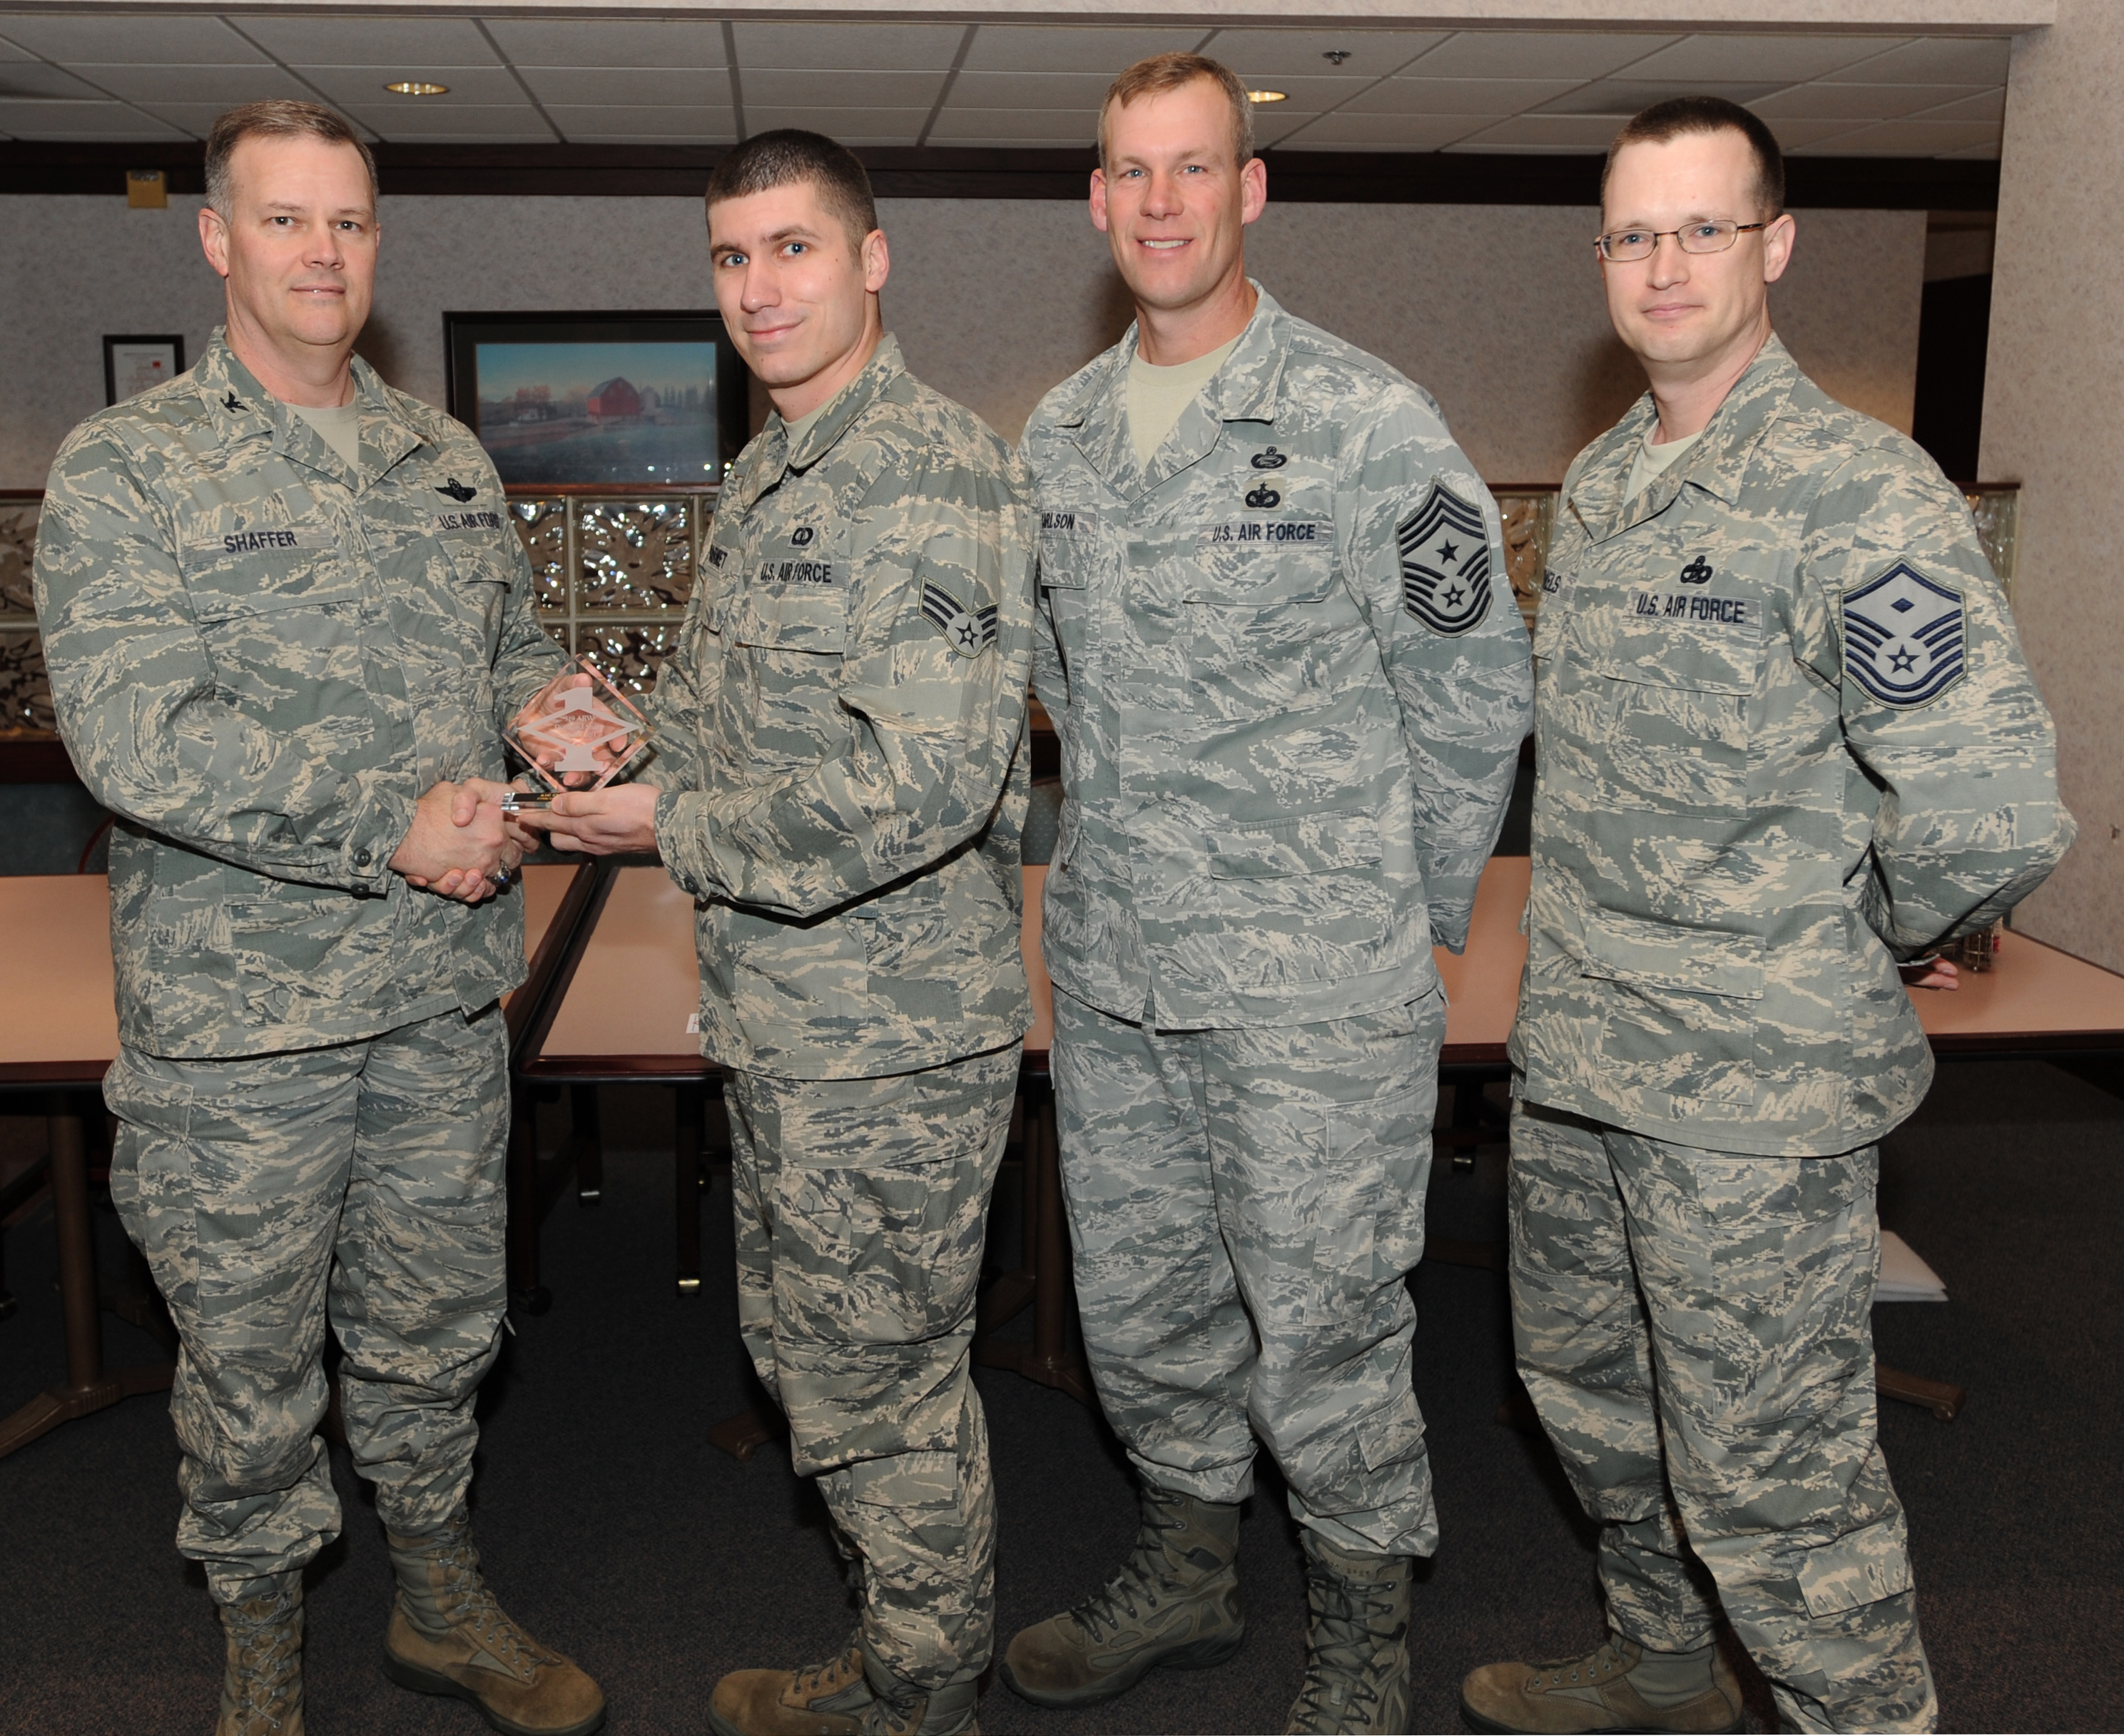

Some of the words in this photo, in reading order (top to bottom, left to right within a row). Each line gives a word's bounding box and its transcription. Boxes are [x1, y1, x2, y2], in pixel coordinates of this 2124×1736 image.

[438, 514, 462, 530] U.S.
[460, 512, 481, 529] AIR
[1212, 524, 1233, 542] U.S.
[1238, 523, 1261, 542] AIR
[1266, 522, 1316, 542] FORCE
[223, 531, 298, 554] SHAFFER
[761, 562, 776, 581] U.S.
[776, 562, 793, 582] AIR
[791, 562, 832, 584] FORCE
[1636, 594, 1659, 616] U.S.
[1663, 595, 1687, 619] AIR
[1689, 597, 1744, 624] FORCE
